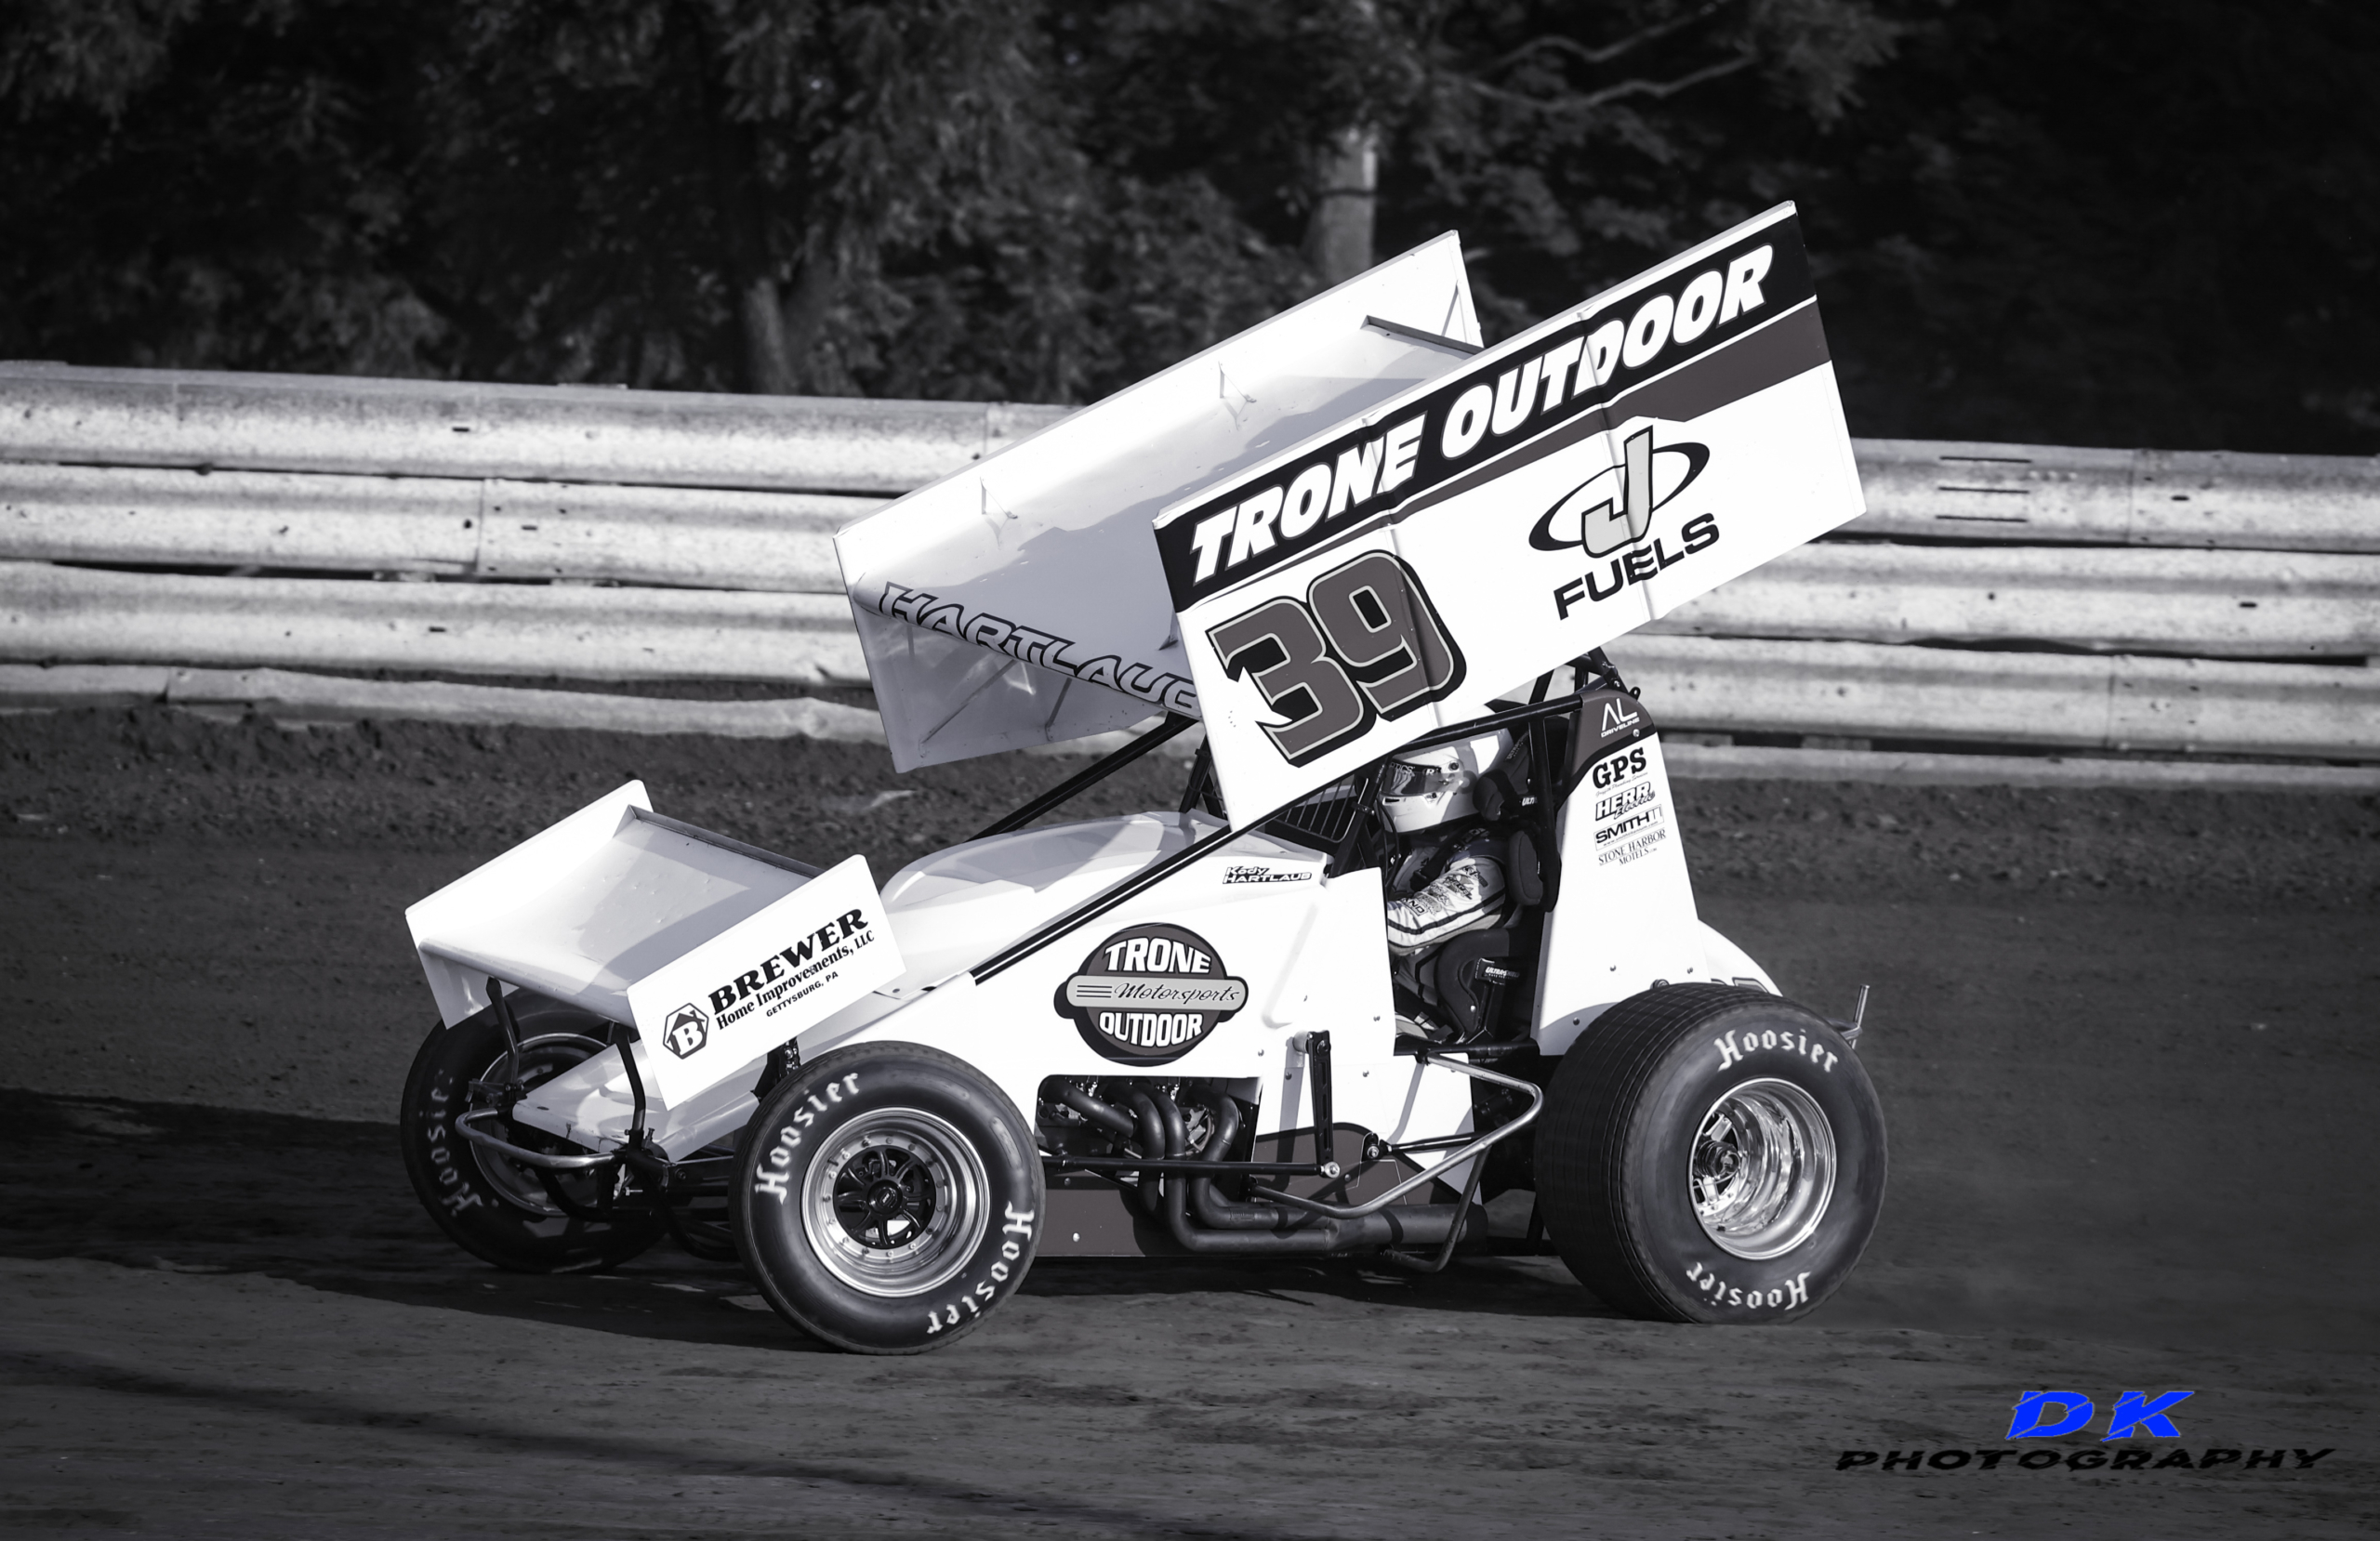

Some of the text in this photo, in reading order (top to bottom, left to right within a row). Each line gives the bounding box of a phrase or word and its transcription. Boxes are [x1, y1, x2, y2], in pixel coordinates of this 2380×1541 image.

[1190, 242, 1775, 586] TRONE OUTDOOR
[1551, 512, 1721, 621] FUELS
[1205, 548, 1468, 769] 39
[1600, 716, 1641, 739] DRIVELINE
[1592, 746, 1647, 790] GPS
[1594, 781, 1651, 822] HERR
[1225, 865, 1270, 876] Kody
[1598, 828, 1667, 867] STONE HARBOR
[1222, 871, 1313, 885] HARTLAUB
[707, 907, 869, 1016] BREWER
[1104, 936, 1212, 975] TRONE
[715, 929, 876, 1031] Home Improvements, LLC
[765, 970, 840, 1018] GETTYSBURG, PA
[1113, 981, 1241, 1006] Motorsports
[1098, 1011, 1204, 1048] OUTDOOR
[1713, 1028, 1839, 1073] Hoosier
[424, 1070, 485, 1218] Hoosier
[754, 1072, 860, 1206] Hoosier
[926, 1200, 1036, 1335] Hoosier
[1685, 1261, 1812, 1311] Hoosier
